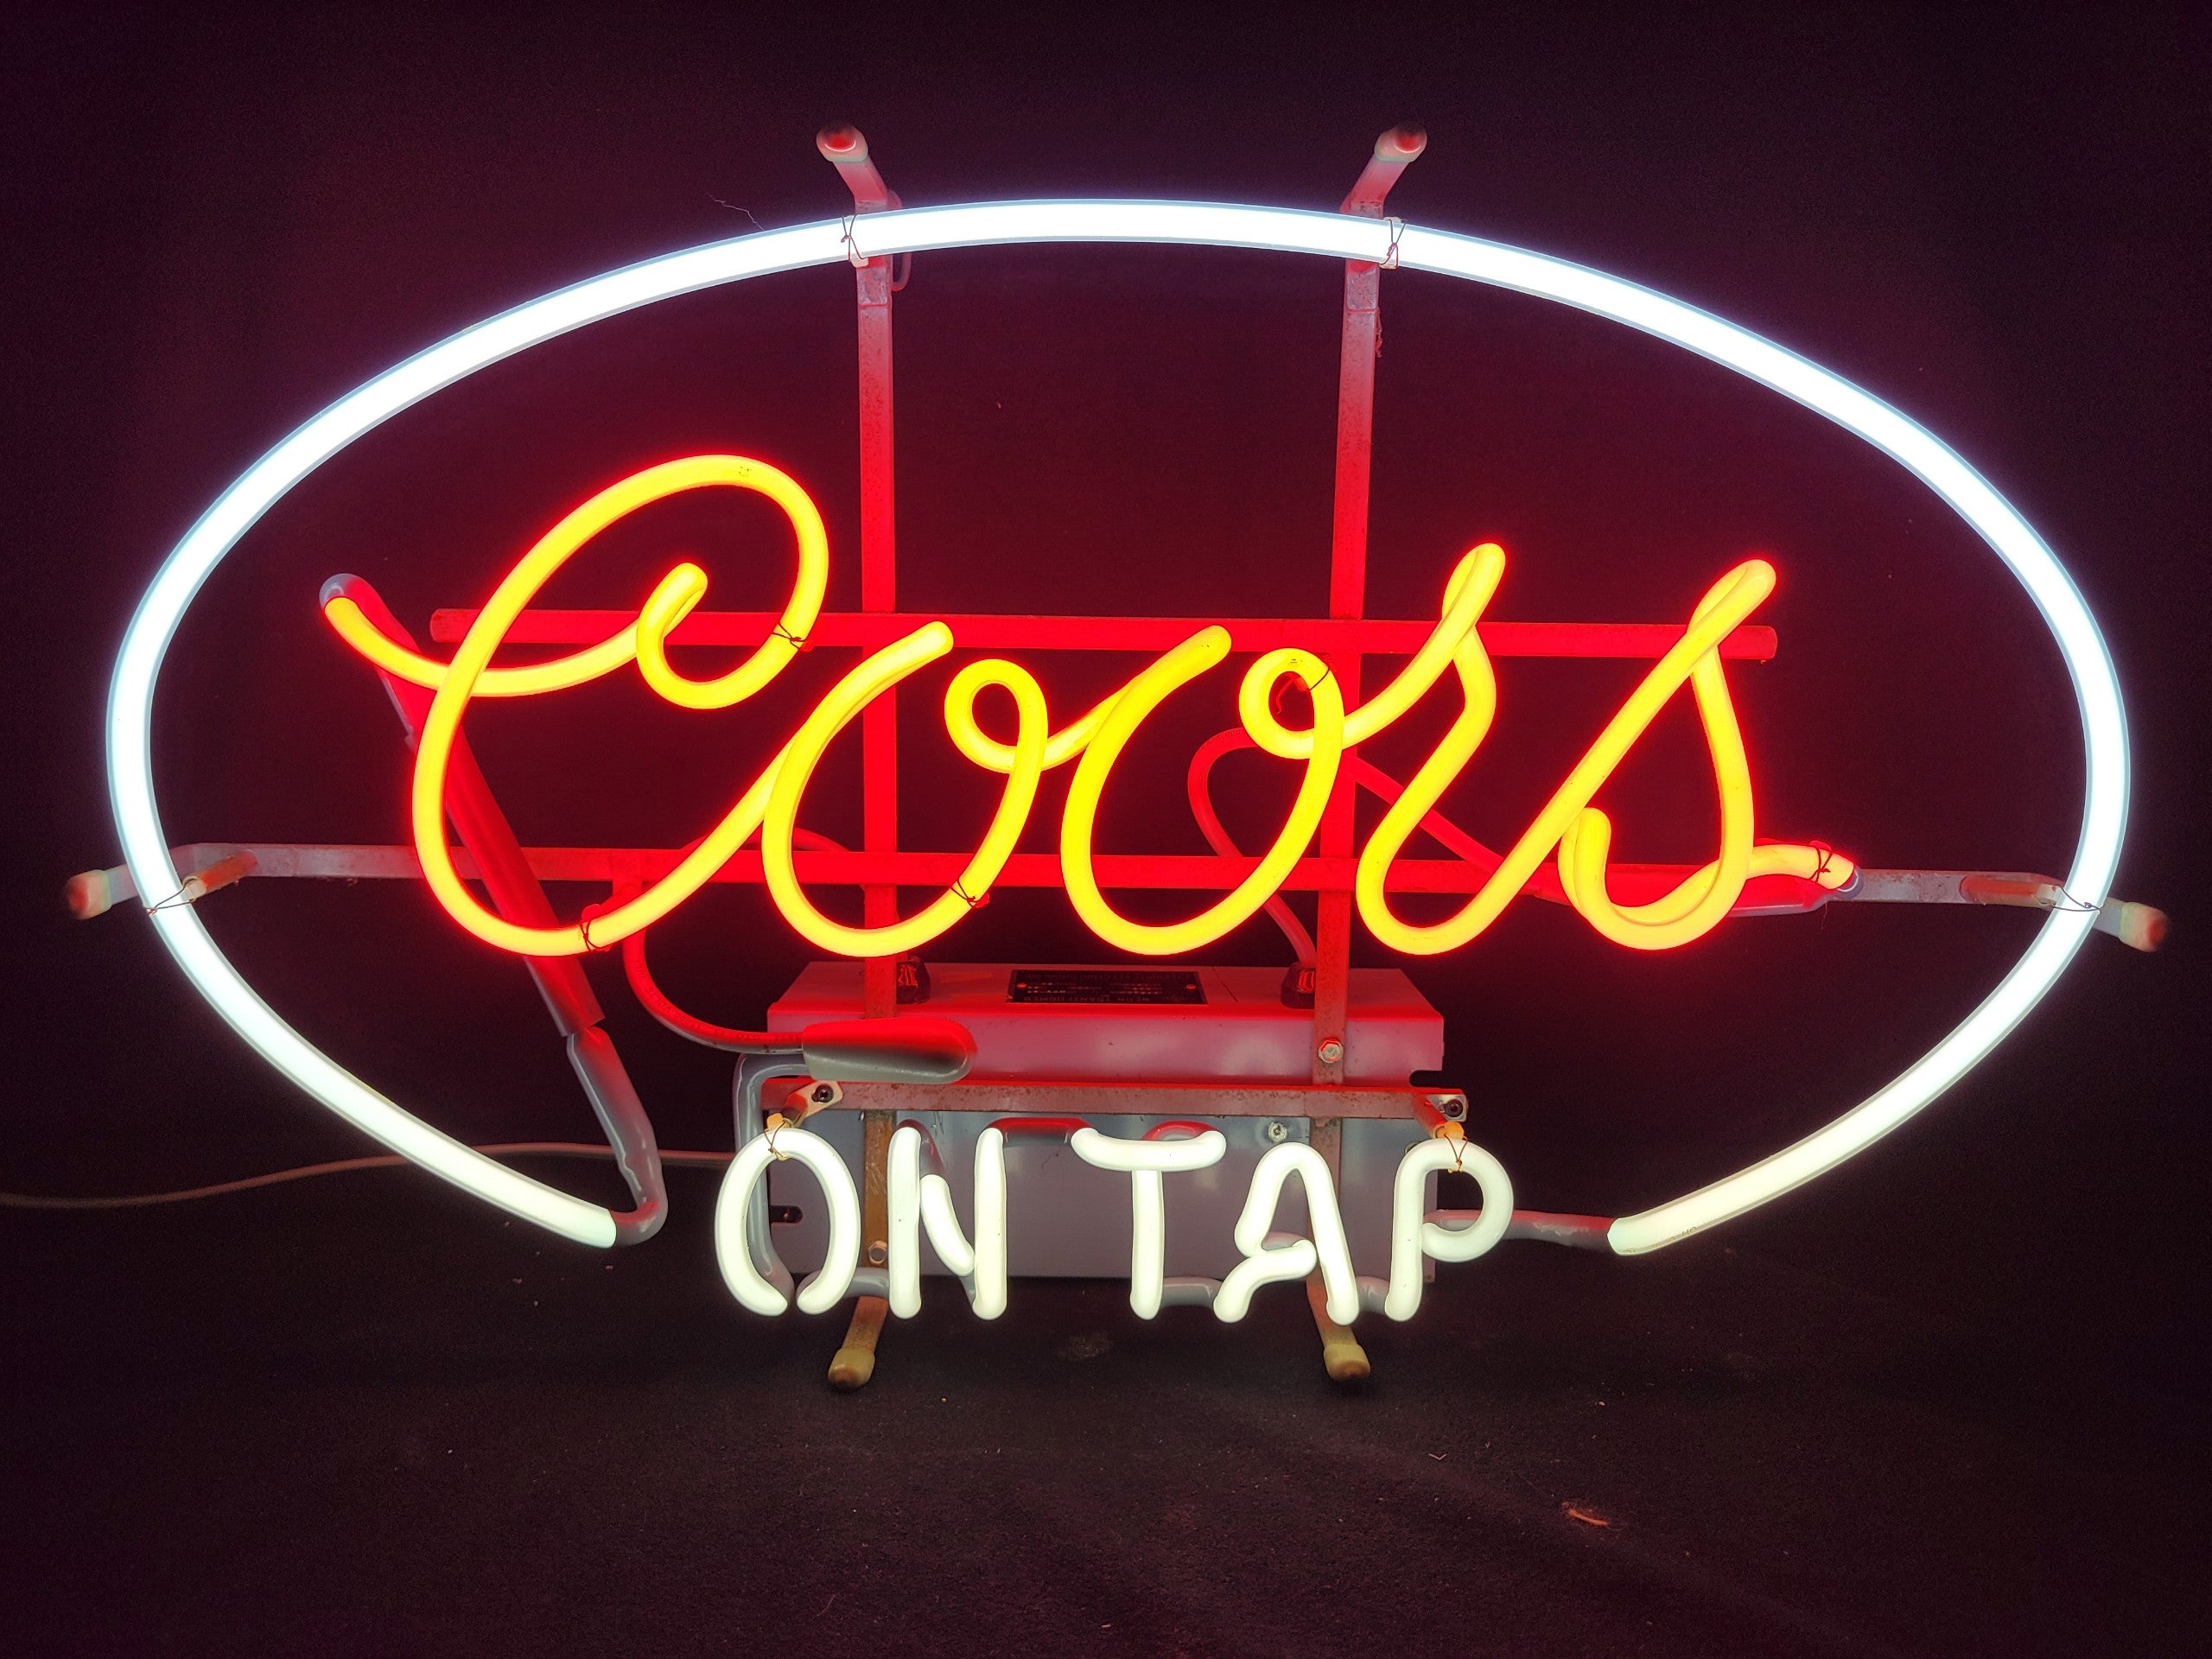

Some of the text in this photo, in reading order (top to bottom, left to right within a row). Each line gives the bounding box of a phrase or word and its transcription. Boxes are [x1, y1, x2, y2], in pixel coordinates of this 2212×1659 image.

[324, 454, 1855, 956] Coors
[715, 1127, 1514, 1325] ON TAP
